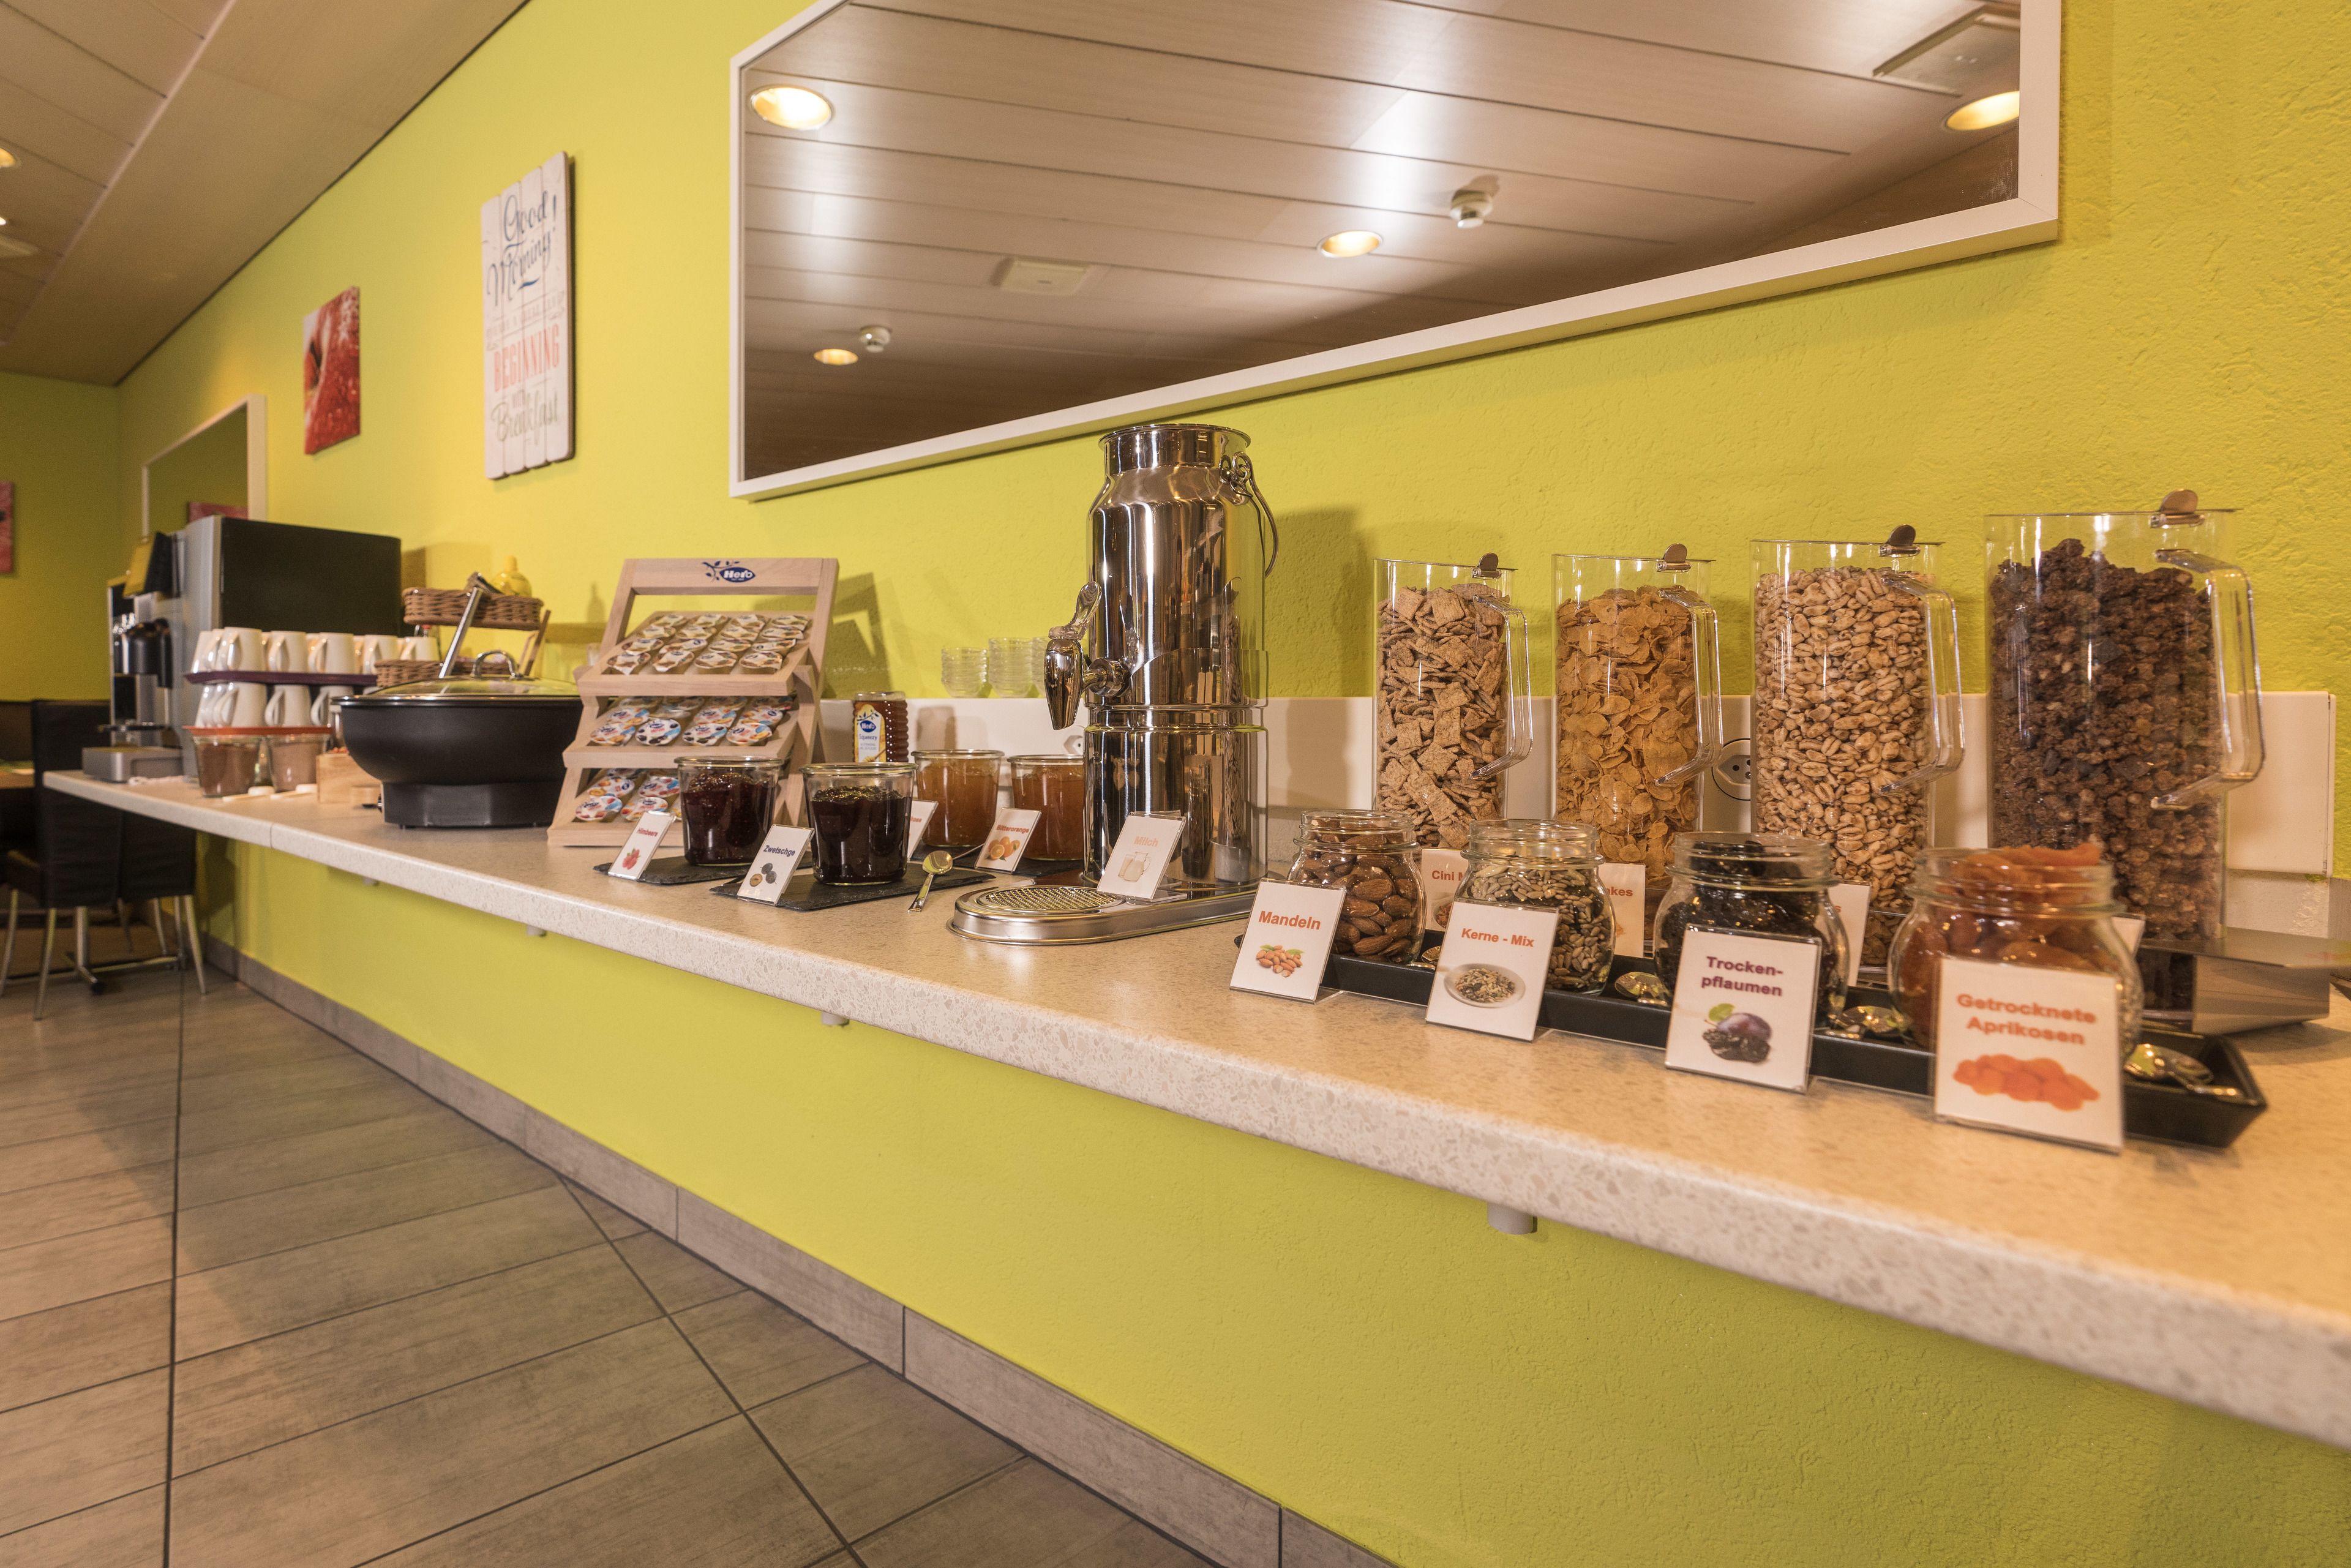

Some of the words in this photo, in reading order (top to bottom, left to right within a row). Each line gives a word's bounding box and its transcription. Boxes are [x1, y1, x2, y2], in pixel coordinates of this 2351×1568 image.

[494, 323, 560, 392] BEGINNING
[490, 389, 558, 445] Breakfast
[723, 570, 753, 579] Hero
[996, 824, 1030, 834] Bitterorange
[763, 844, 796, 857] Zwetschge
[1134, 836, 1159, 847] Milch
[1431, 870, 1455, 880] Cini
[1258, 910, 1321, 930] Mandeln
[1461, 928, 1499, 942] Kerne
[1510, 934, 1535, 947] Mix
[1706, 956, 1783, 976] Trocken-
[1701, 975, 1782, 997] pflaumen
[1956, 993, 2096, 1024] Getrocknete
[1966, 1015, 2085, 1045] Aprikosen
